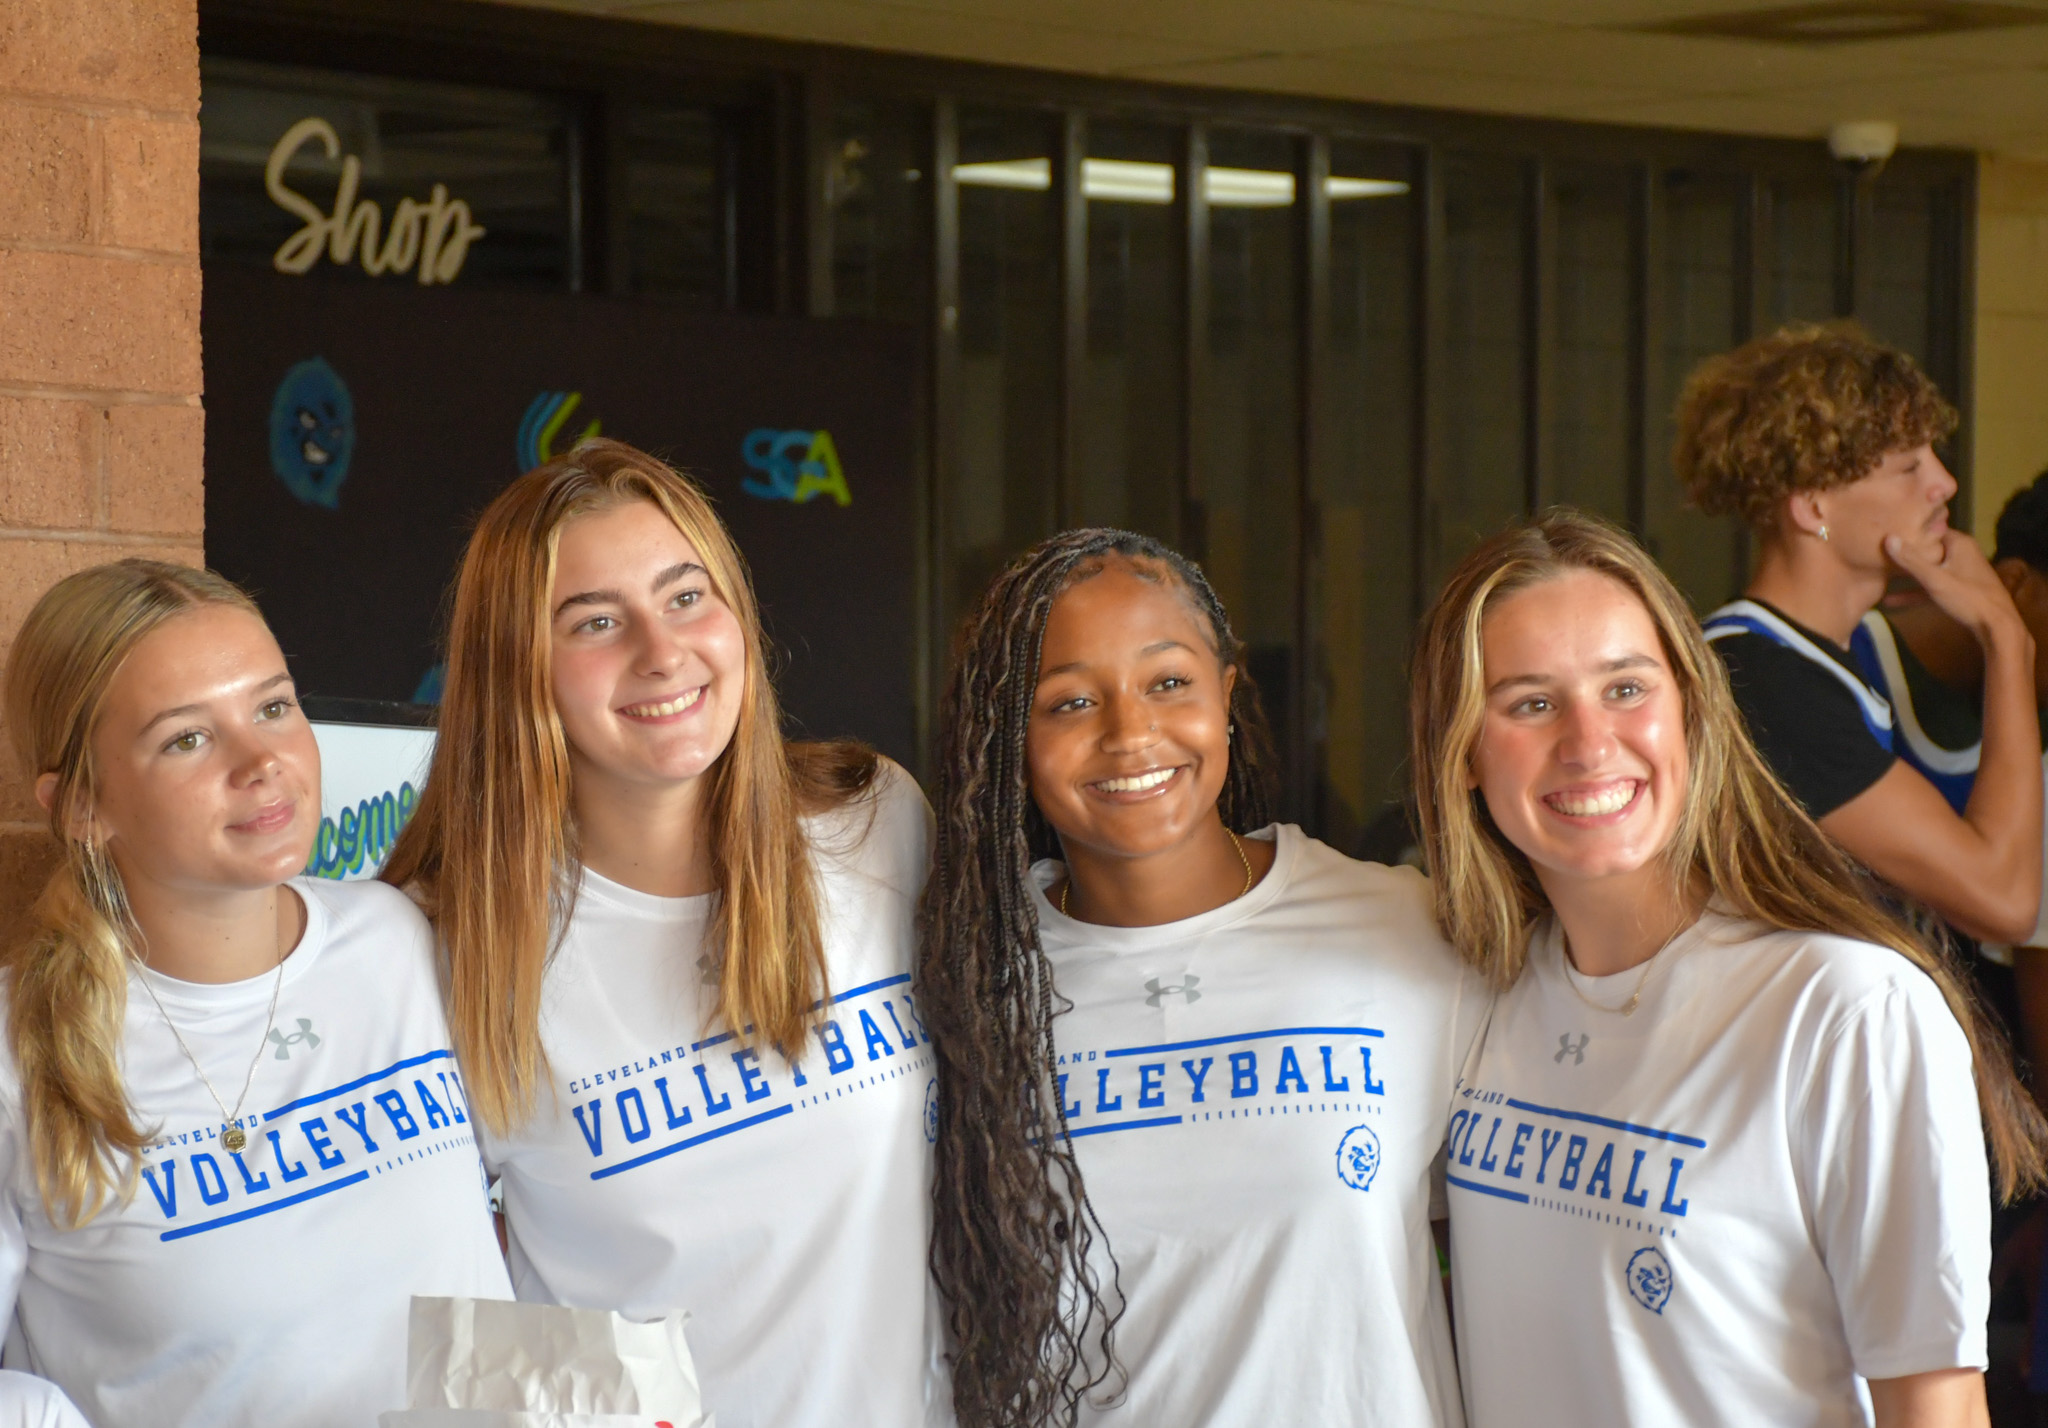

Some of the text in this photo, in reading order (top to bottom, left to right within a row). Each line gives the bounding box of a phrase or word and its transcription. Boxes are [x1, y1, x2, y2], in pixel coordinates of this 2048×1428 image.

[265, 117, 485, 284] Shop
[304, 781, 419, 880] come
[570, 1046, 686, 1094] CLEVELAND
[1055, 1045, 1385, 1121] LLEYBALL
[1447, 1108, 1690, 1218] OLLEYBALL
